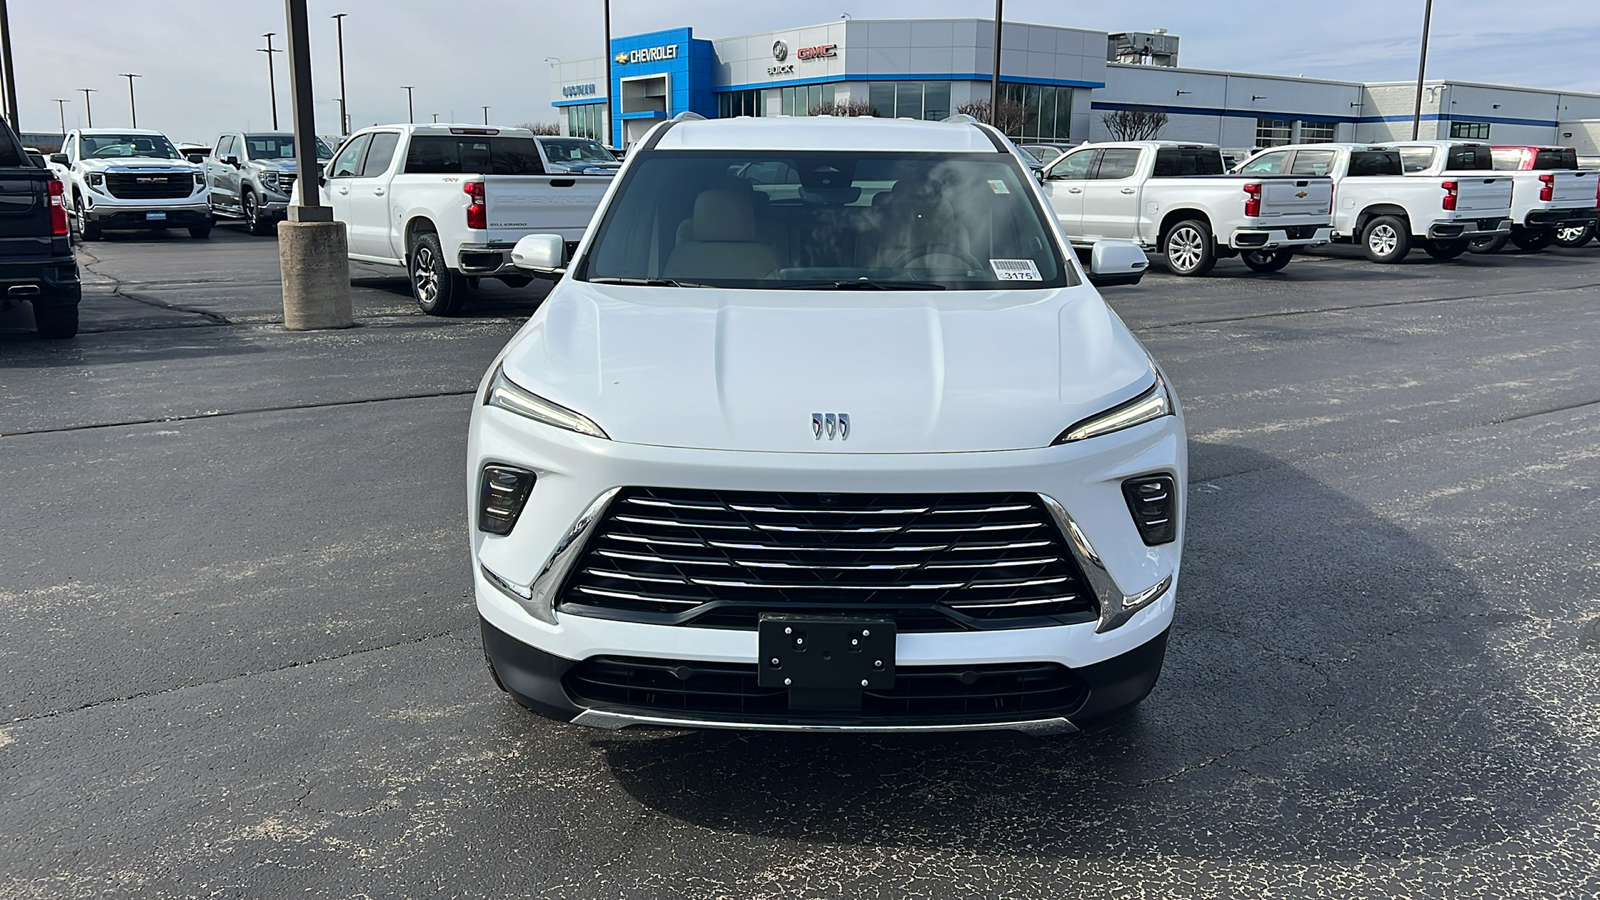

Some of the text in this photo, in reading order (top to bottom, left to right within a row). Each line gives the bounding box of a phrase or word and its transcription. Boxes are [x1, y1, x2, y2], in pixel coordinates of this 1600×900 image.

[630, 44, 679, 63] CHEVROLET
[797, 44, 837, 60] GMC
[767, 65, 794, 75] BUICK
[497, 195, 601, 206] CHEVROL
[1005, 272, 1033, 280] 3175
